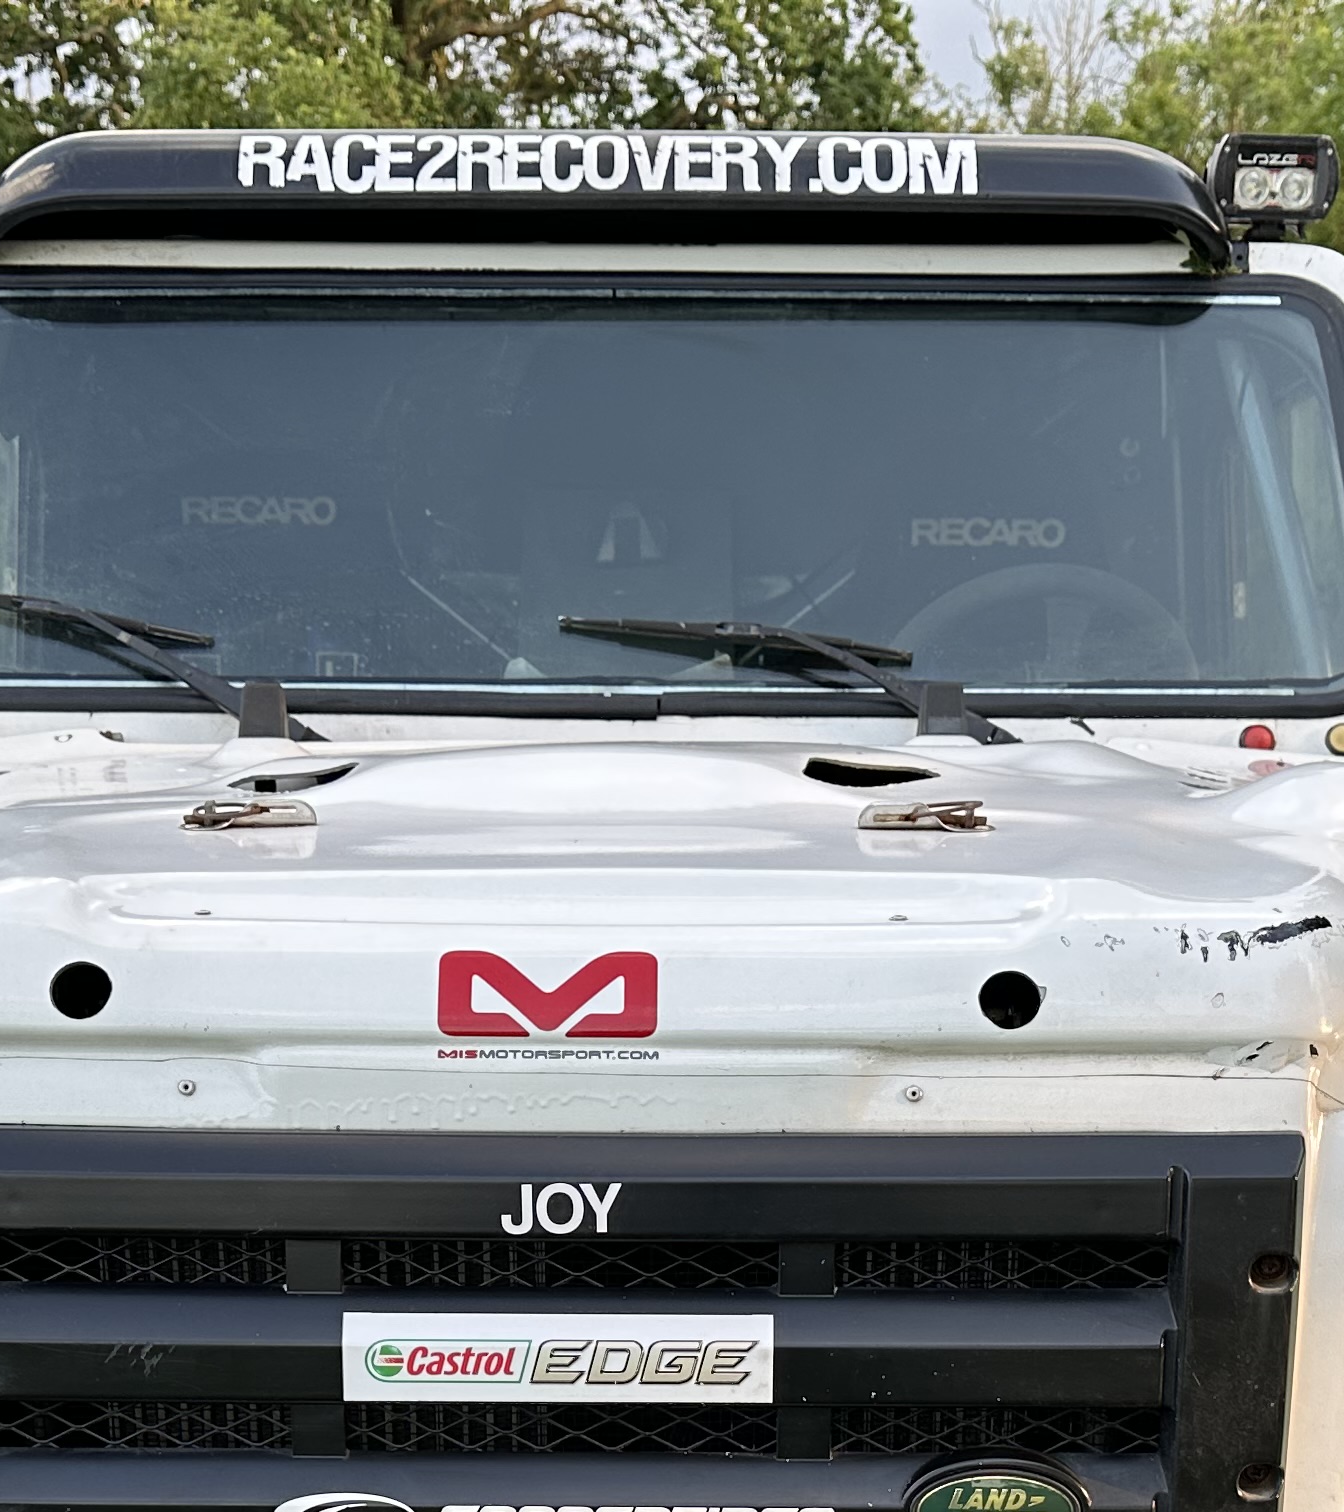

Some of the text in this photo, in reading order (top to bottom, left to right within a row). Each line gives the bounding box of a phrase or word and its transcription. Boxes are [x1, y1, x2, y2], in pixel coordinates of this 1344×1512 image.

[238, 134, 978, 196] RACE2RECOVERY.COM
[181, 496, 337, 525] RECARO
[911, 517, 1065, 548] RECARO
[438, 1049, 659, 1061] MISMOTORSPORT.COM
[501, 1183, 622, 1235] JOY
[407, 1339, 760, 1385] Castrol EDGE
[948, 1488, 1028, 1511] LAND
